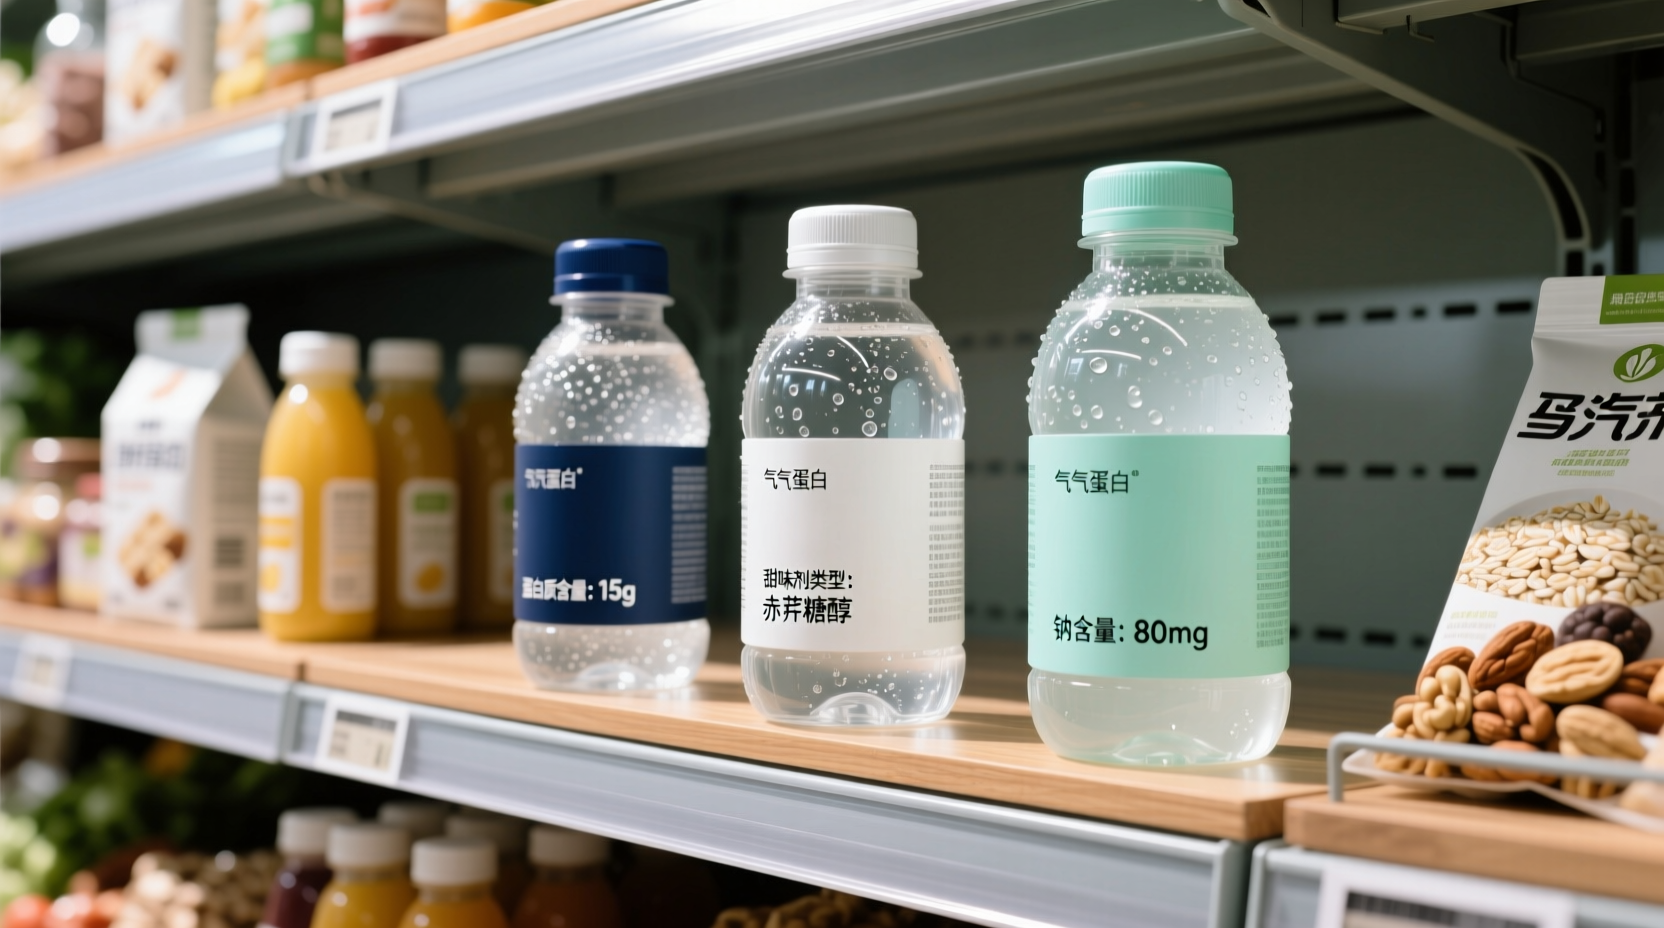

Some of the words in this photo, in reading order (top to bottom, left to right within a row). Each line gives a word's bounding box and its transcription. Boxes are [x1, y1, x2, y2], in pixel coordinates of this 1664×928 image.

[764, 468, 827, 491] 气气蛋白
[598, 578, 636, 608] 15g
[1133, 619, 1209, 651] 80mg
